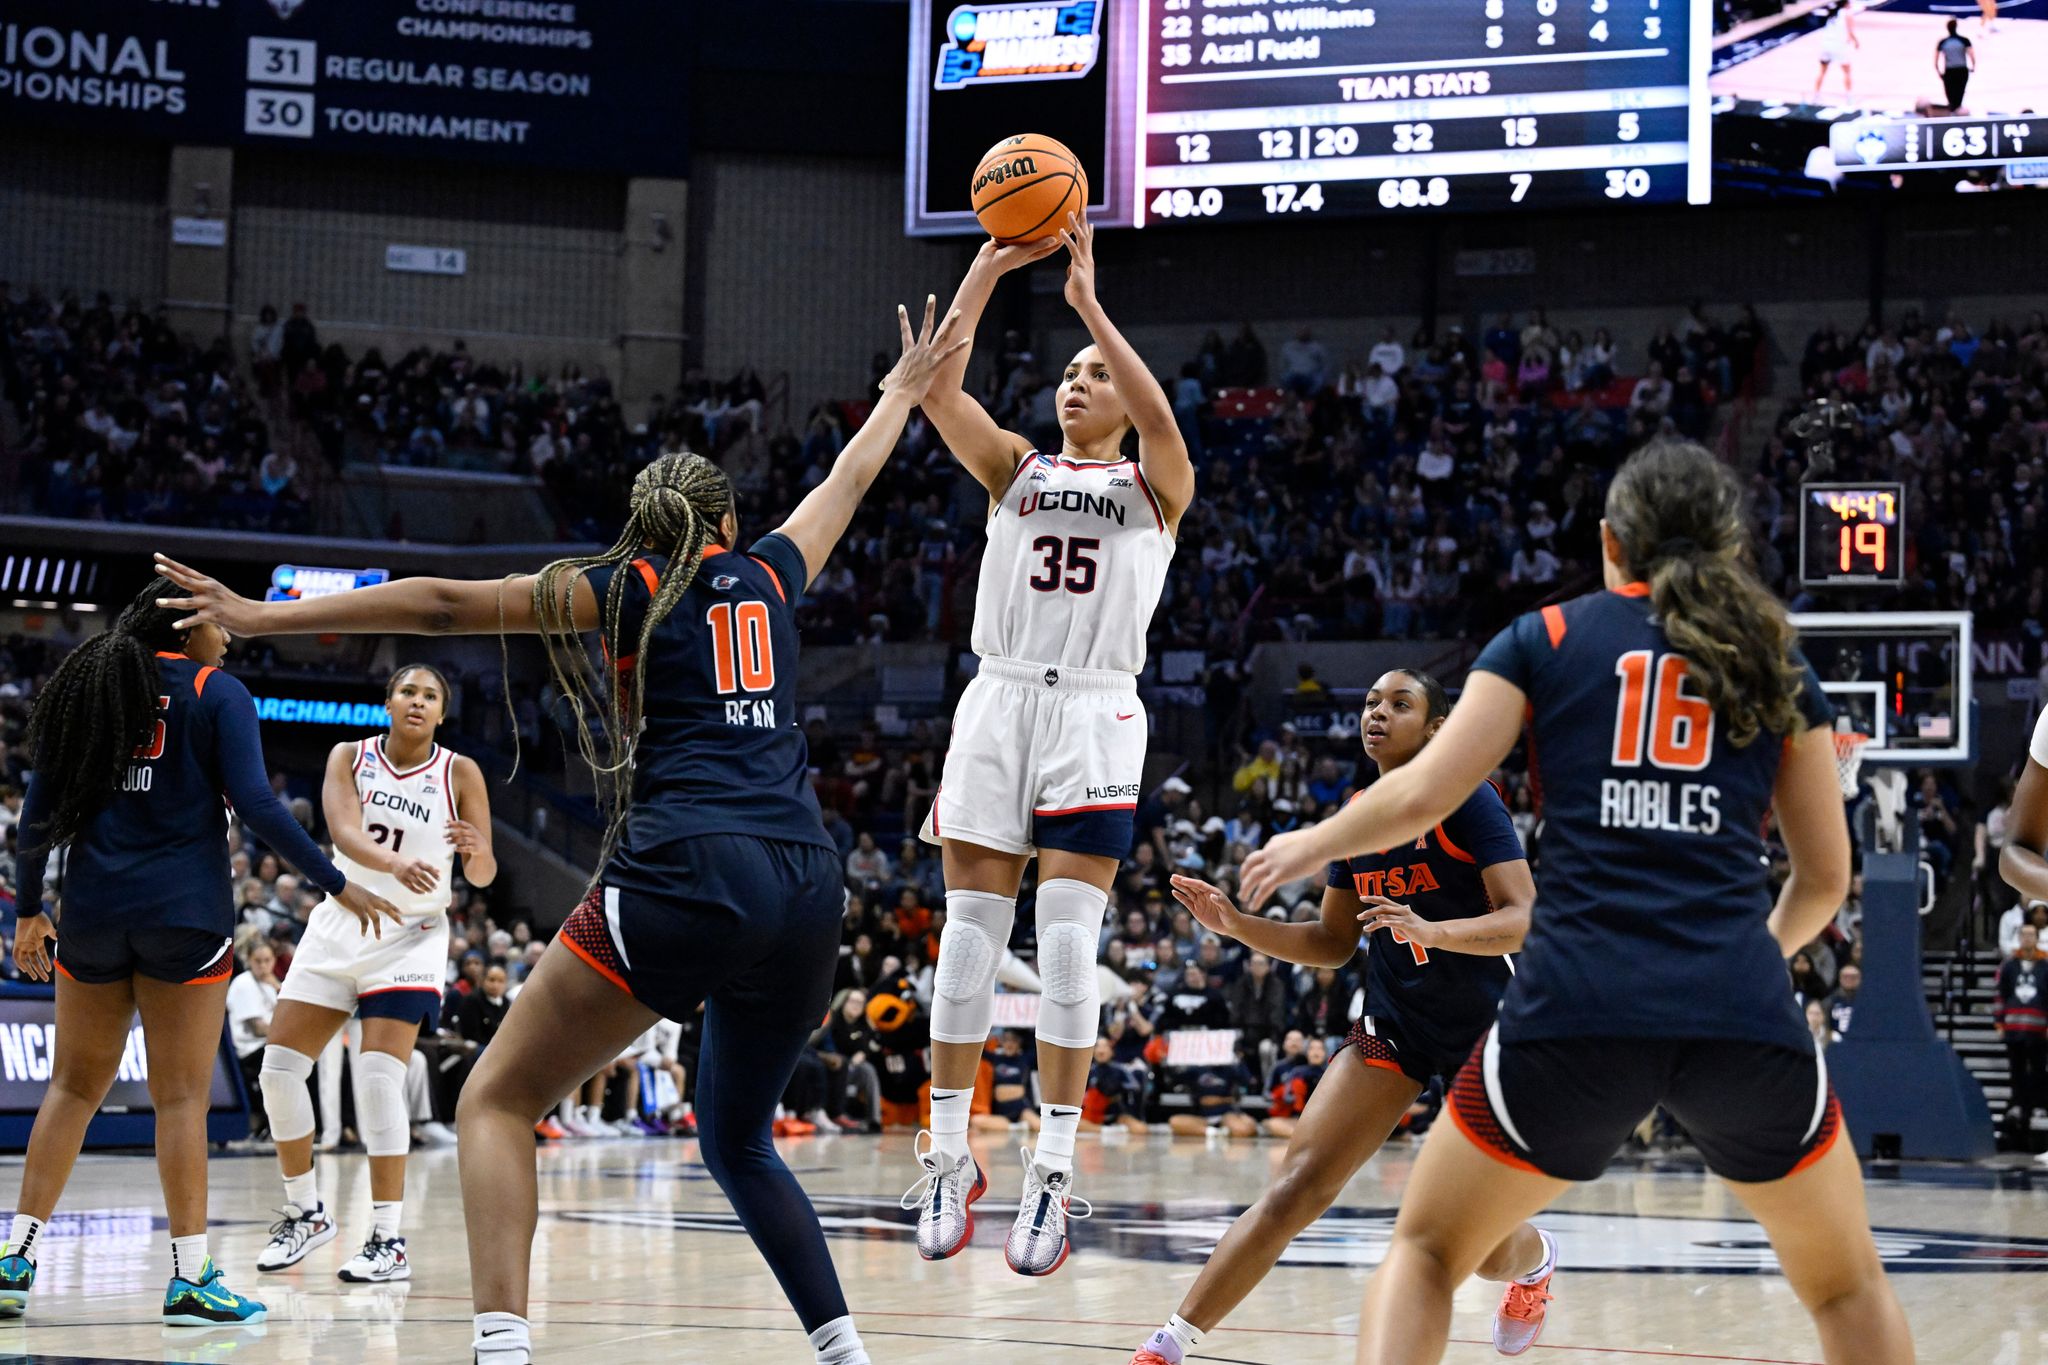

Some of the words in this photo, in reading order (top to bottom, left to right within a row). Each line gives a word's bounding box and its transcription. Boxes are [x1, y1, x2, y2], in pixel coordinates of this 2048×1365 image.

[397, 17, 593, 49] CHAMPIONSHIPS
[1161, 15, 1193, 38] 22
[1201, 11, 1270, 36] Serah
[1273, 7, 1376, 32] Williams
[0, 22, 186, 82] IONAL
[1161, 43, 1192, 67] 35
[1200, 39, 1255, 65] Azzi
[1257, 35, 1321, 62] Fudd
[1485, 25, 1504, 49] 5
[1537, 22, 1556, 46] 2
[1588, 19, 1609, 42] 4
[1643, 16, 1662, 40] 3
[265, 47, 300, 75] 31
[325, 55, 464, 88] REGULAR
[472, 66, 590, 96] SEASON
[1338, 76, 1412, 101] TEAM
[1413, 71, 1491, 97] STATS
[256, 98, 303, 127] 30
[324, 107, 530, 144] TOURNAMENT
[1501, 117, 1538, 147] 15
[1617, 112, 1640, 141] 5
[1176, 133, 1211, 162] 12
[1258, 130, 1294, 159] 12
[1313, 126, 1360, 156] 20
[1392, 123, 1434, 153] 32
[1942, 126, 1987, 157] 63
[973, 156, 1037, 196] Wilson
[1509, 173, 1532, 202] 7
[1604, 168, 1650, 199] 30
[1150, 187, 1224, 218] 49.0
[1261, 183, 1325, 213] 17.4
[1377, 177, 1450, 208] 68.8
[1018, 489, 1126, 527] UCONN
[1830, 492, 1895, 521] 4:47
[1840, 523, 1886, 572] 19
[1029, 535, 1101, 595] 35
[706, 600, 775, 695] 10
[724, 699, 776, 729] BEAN
[1610, 649, 1716, 772] 16
[1086, 784, 1140, 800] HUSKIES
[1599, 778, 1721, 836] ROBLES
[367, 822, 405, 854] 21
[1352, 862, 1441, 897] UTSA
